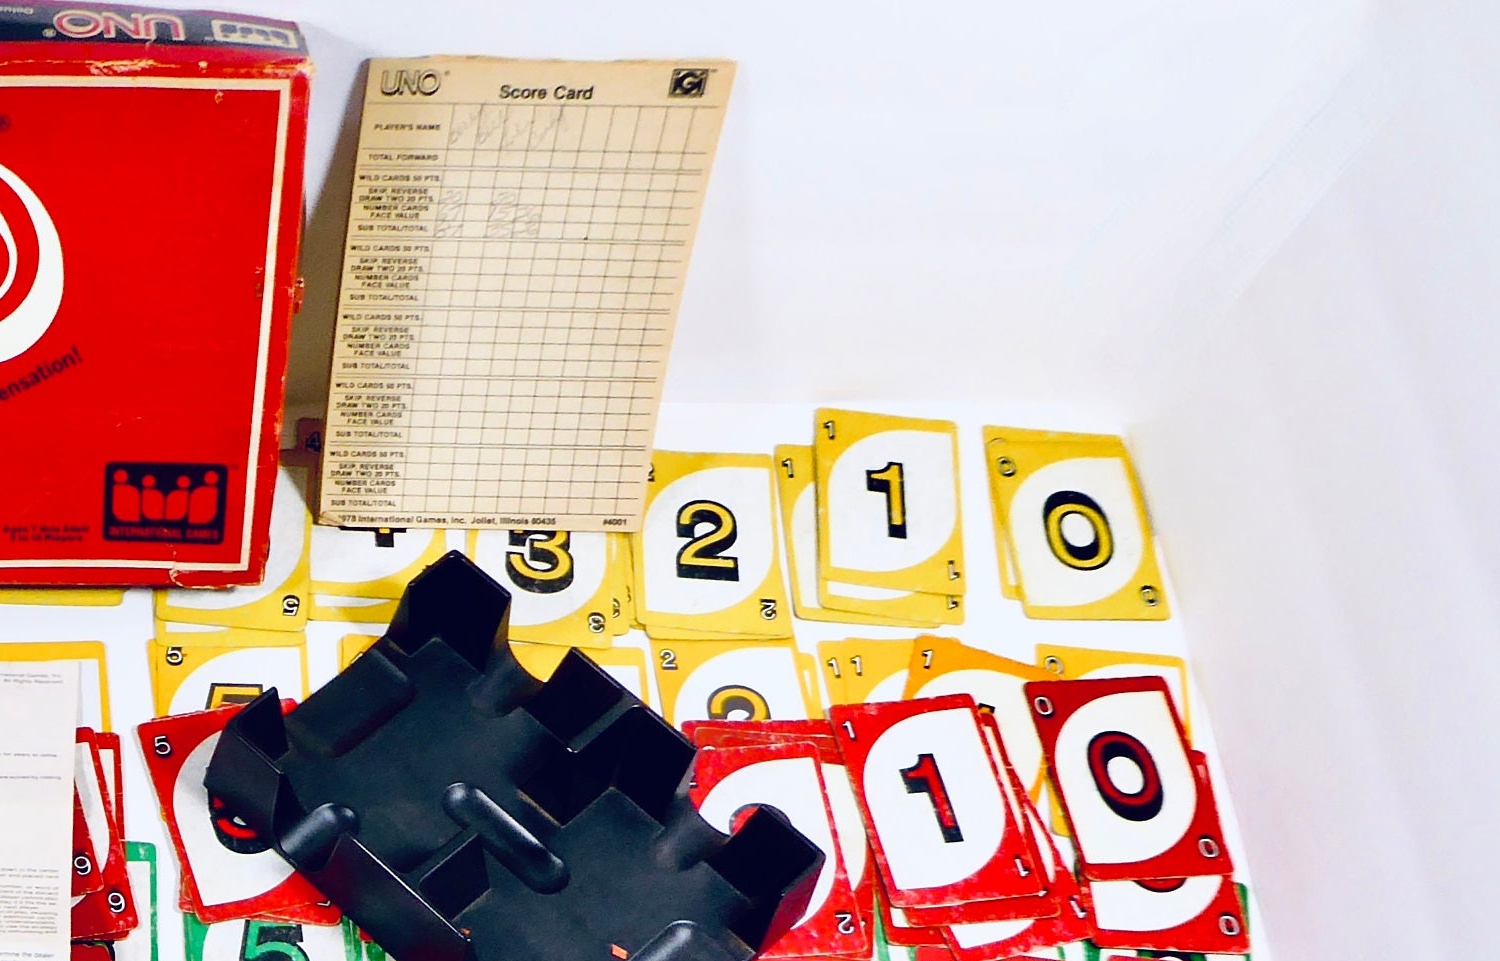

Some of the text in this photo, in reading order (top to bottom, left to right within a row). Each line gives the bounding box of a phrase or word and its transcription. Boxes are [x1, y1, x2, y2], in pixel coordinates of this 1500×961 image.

[53, 9, 185, 41] UNO
[381, 69, 441, 96] UNO
[500, 85, 594, 100] Score Card
[109, 526, 218, 539] INTERNATIONAL GAMES
[866, 461, 907, 539] 1
[1043, 490, 1115, 571] 0
[676, 500, 739, 582] 2
[899, 753, 964, 844] 1
[1086, 730, 1164, 822] 0
